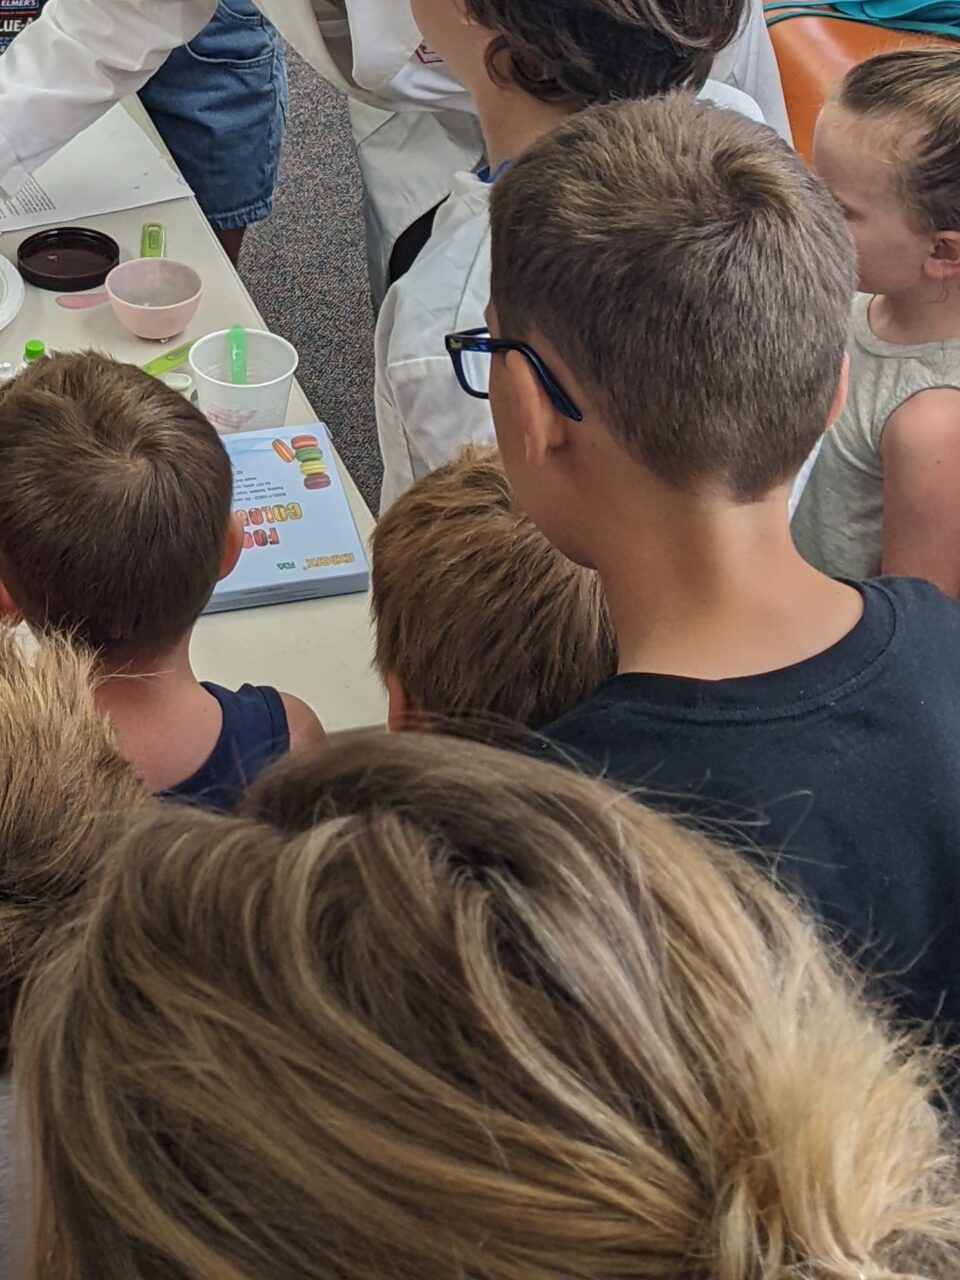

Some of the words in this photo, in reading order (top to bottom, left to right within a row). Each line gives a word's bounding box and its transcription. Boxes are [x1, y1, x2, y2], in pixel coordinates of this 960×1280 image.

[1, 0, 36, 7] ELMER'S
[242, 528, 280, 549] FOO
[276, 560, 296, 571] FDA
